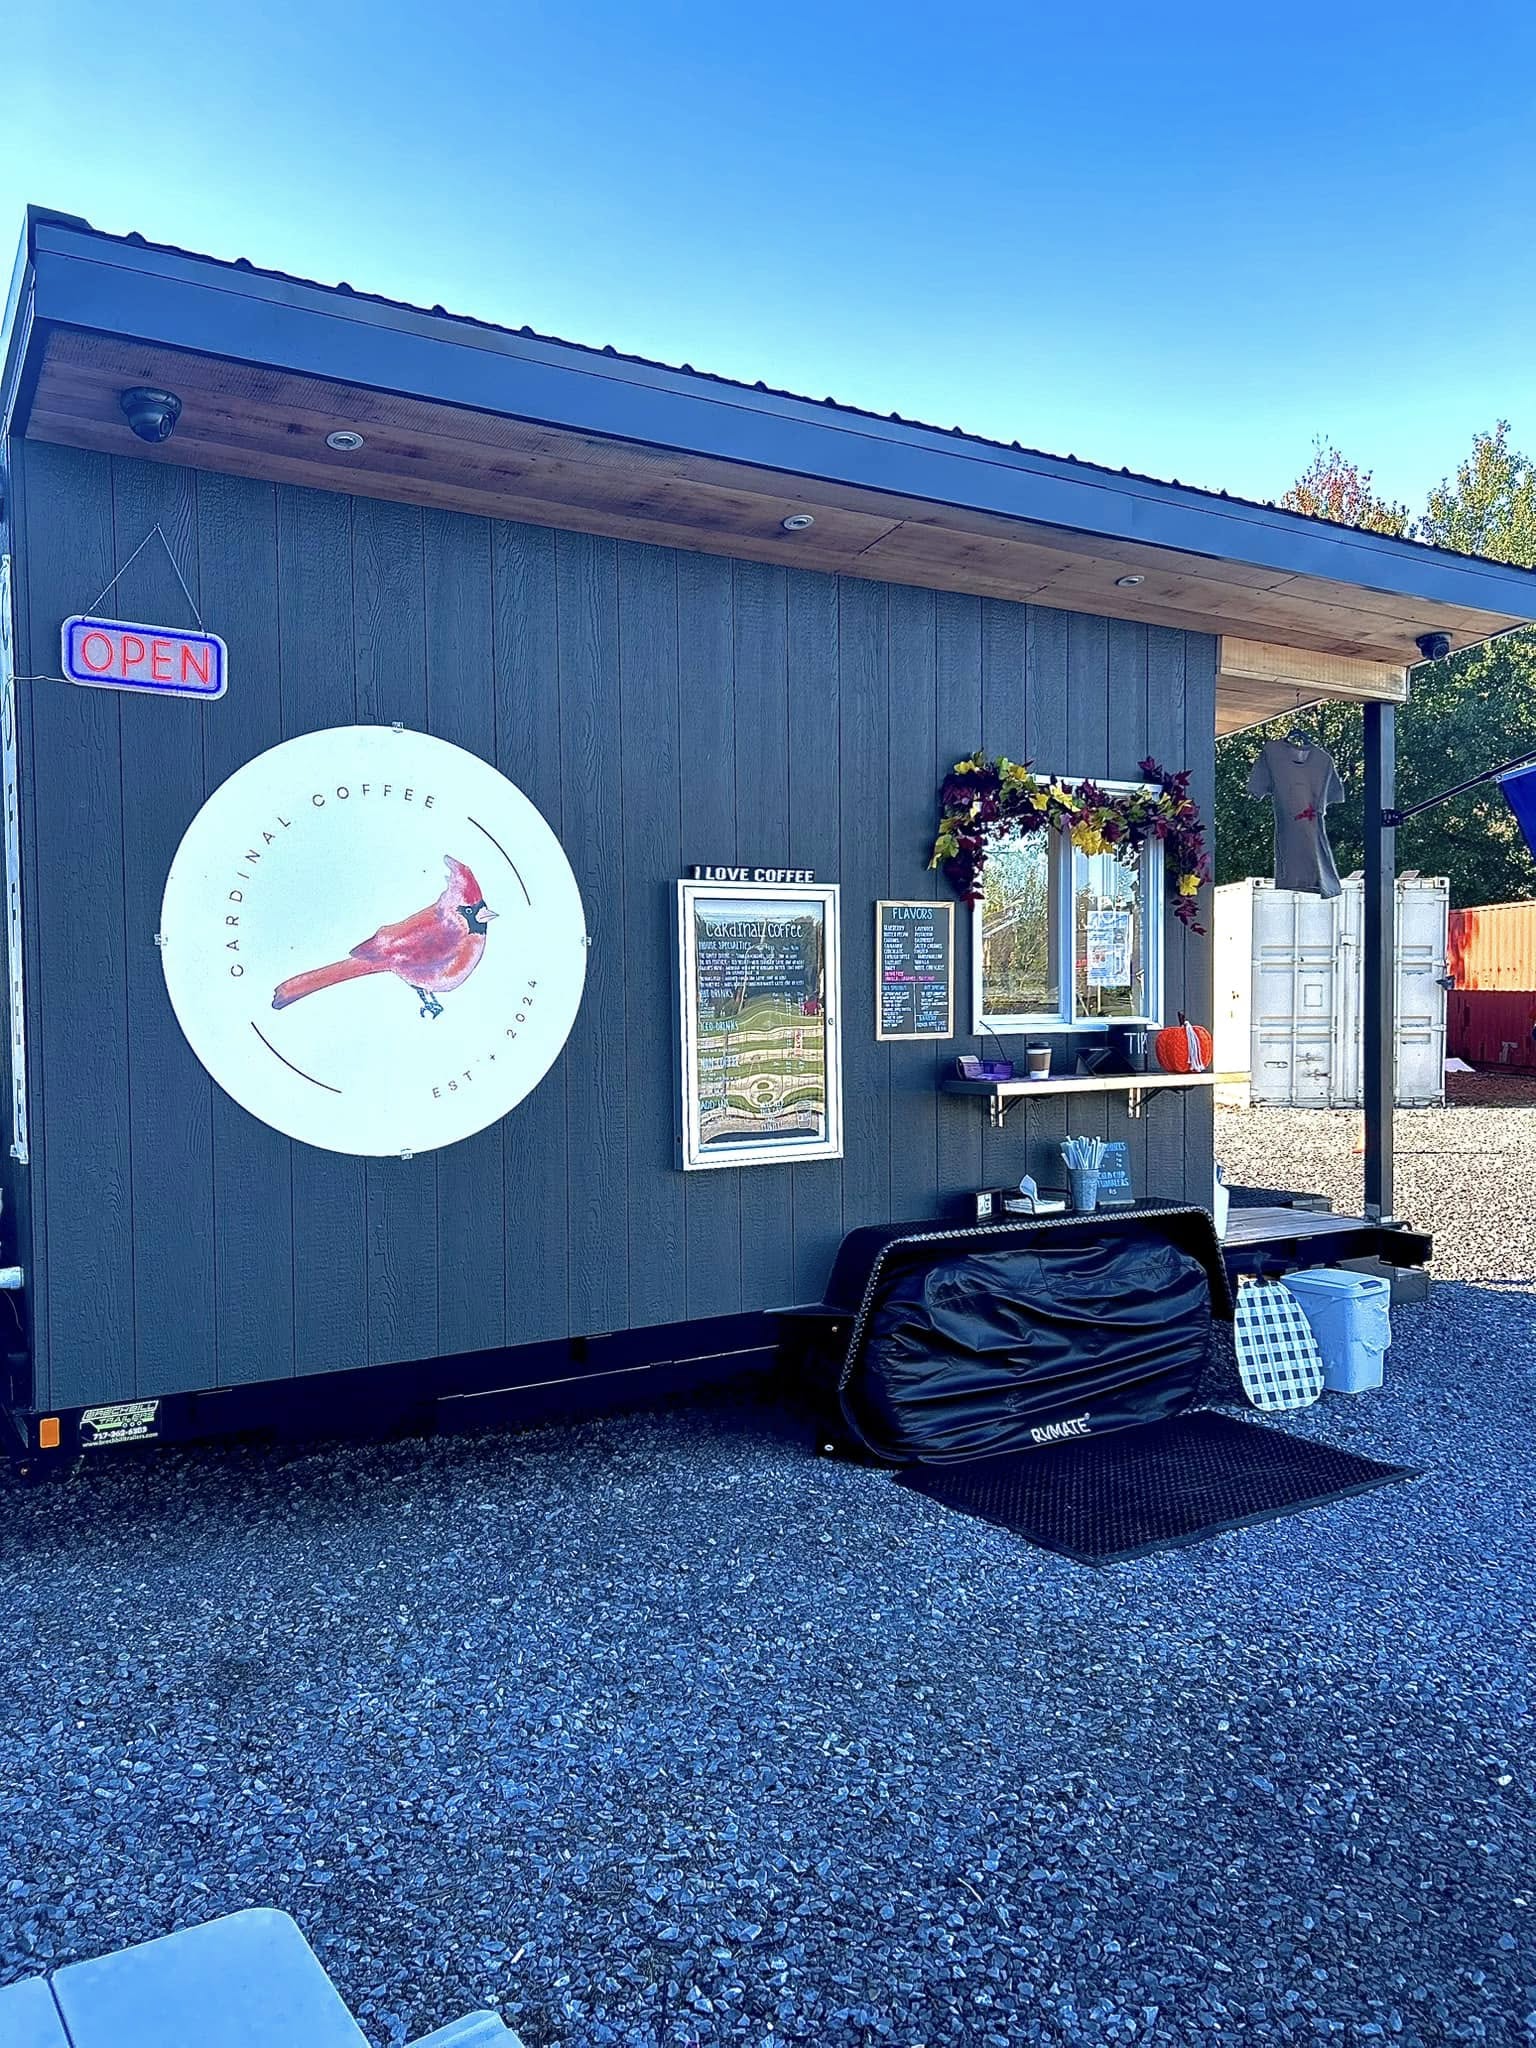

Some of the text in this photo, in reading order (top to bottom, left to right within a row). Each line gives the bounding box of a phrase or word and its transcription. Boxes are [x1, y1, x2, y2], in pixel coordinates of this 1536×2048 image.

[81, 631, 210, 684] OPEN
[225, 783, 435, 978] CARDINAL COFFEE
[695, 866, 814, 883] I LOVE COFFEE
[892, 907, 933, 920] FLAVORS
[506, 978, 538, 1040] 2024
[1031, 1418, 1092, 1443] RVMATE
